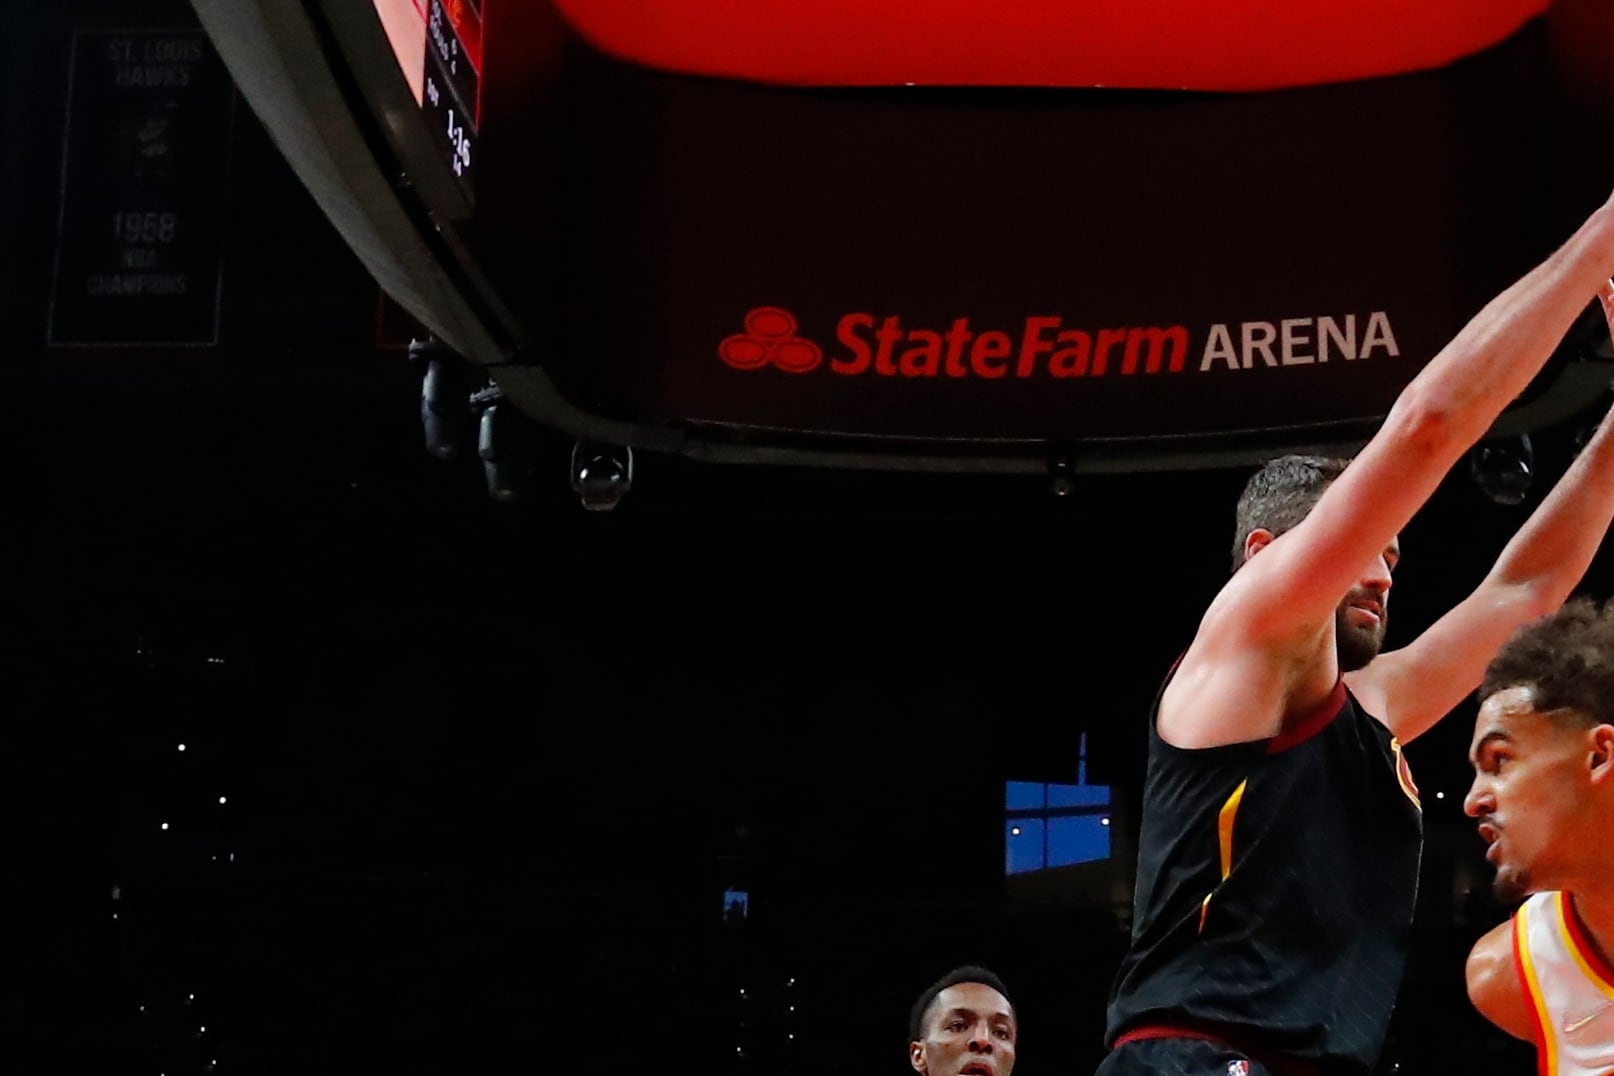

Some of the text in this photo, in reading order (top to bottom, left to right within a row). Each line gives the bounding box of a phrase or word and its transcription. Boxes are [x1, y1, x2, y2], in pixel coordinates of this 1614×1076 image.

[114, 64, 192, 87] HAWKS
[111, 210, 178, 244] 1958
[85, 272, 189, 296] CHAMPIONS
[1199, 311, 1400, 372] ARENA
